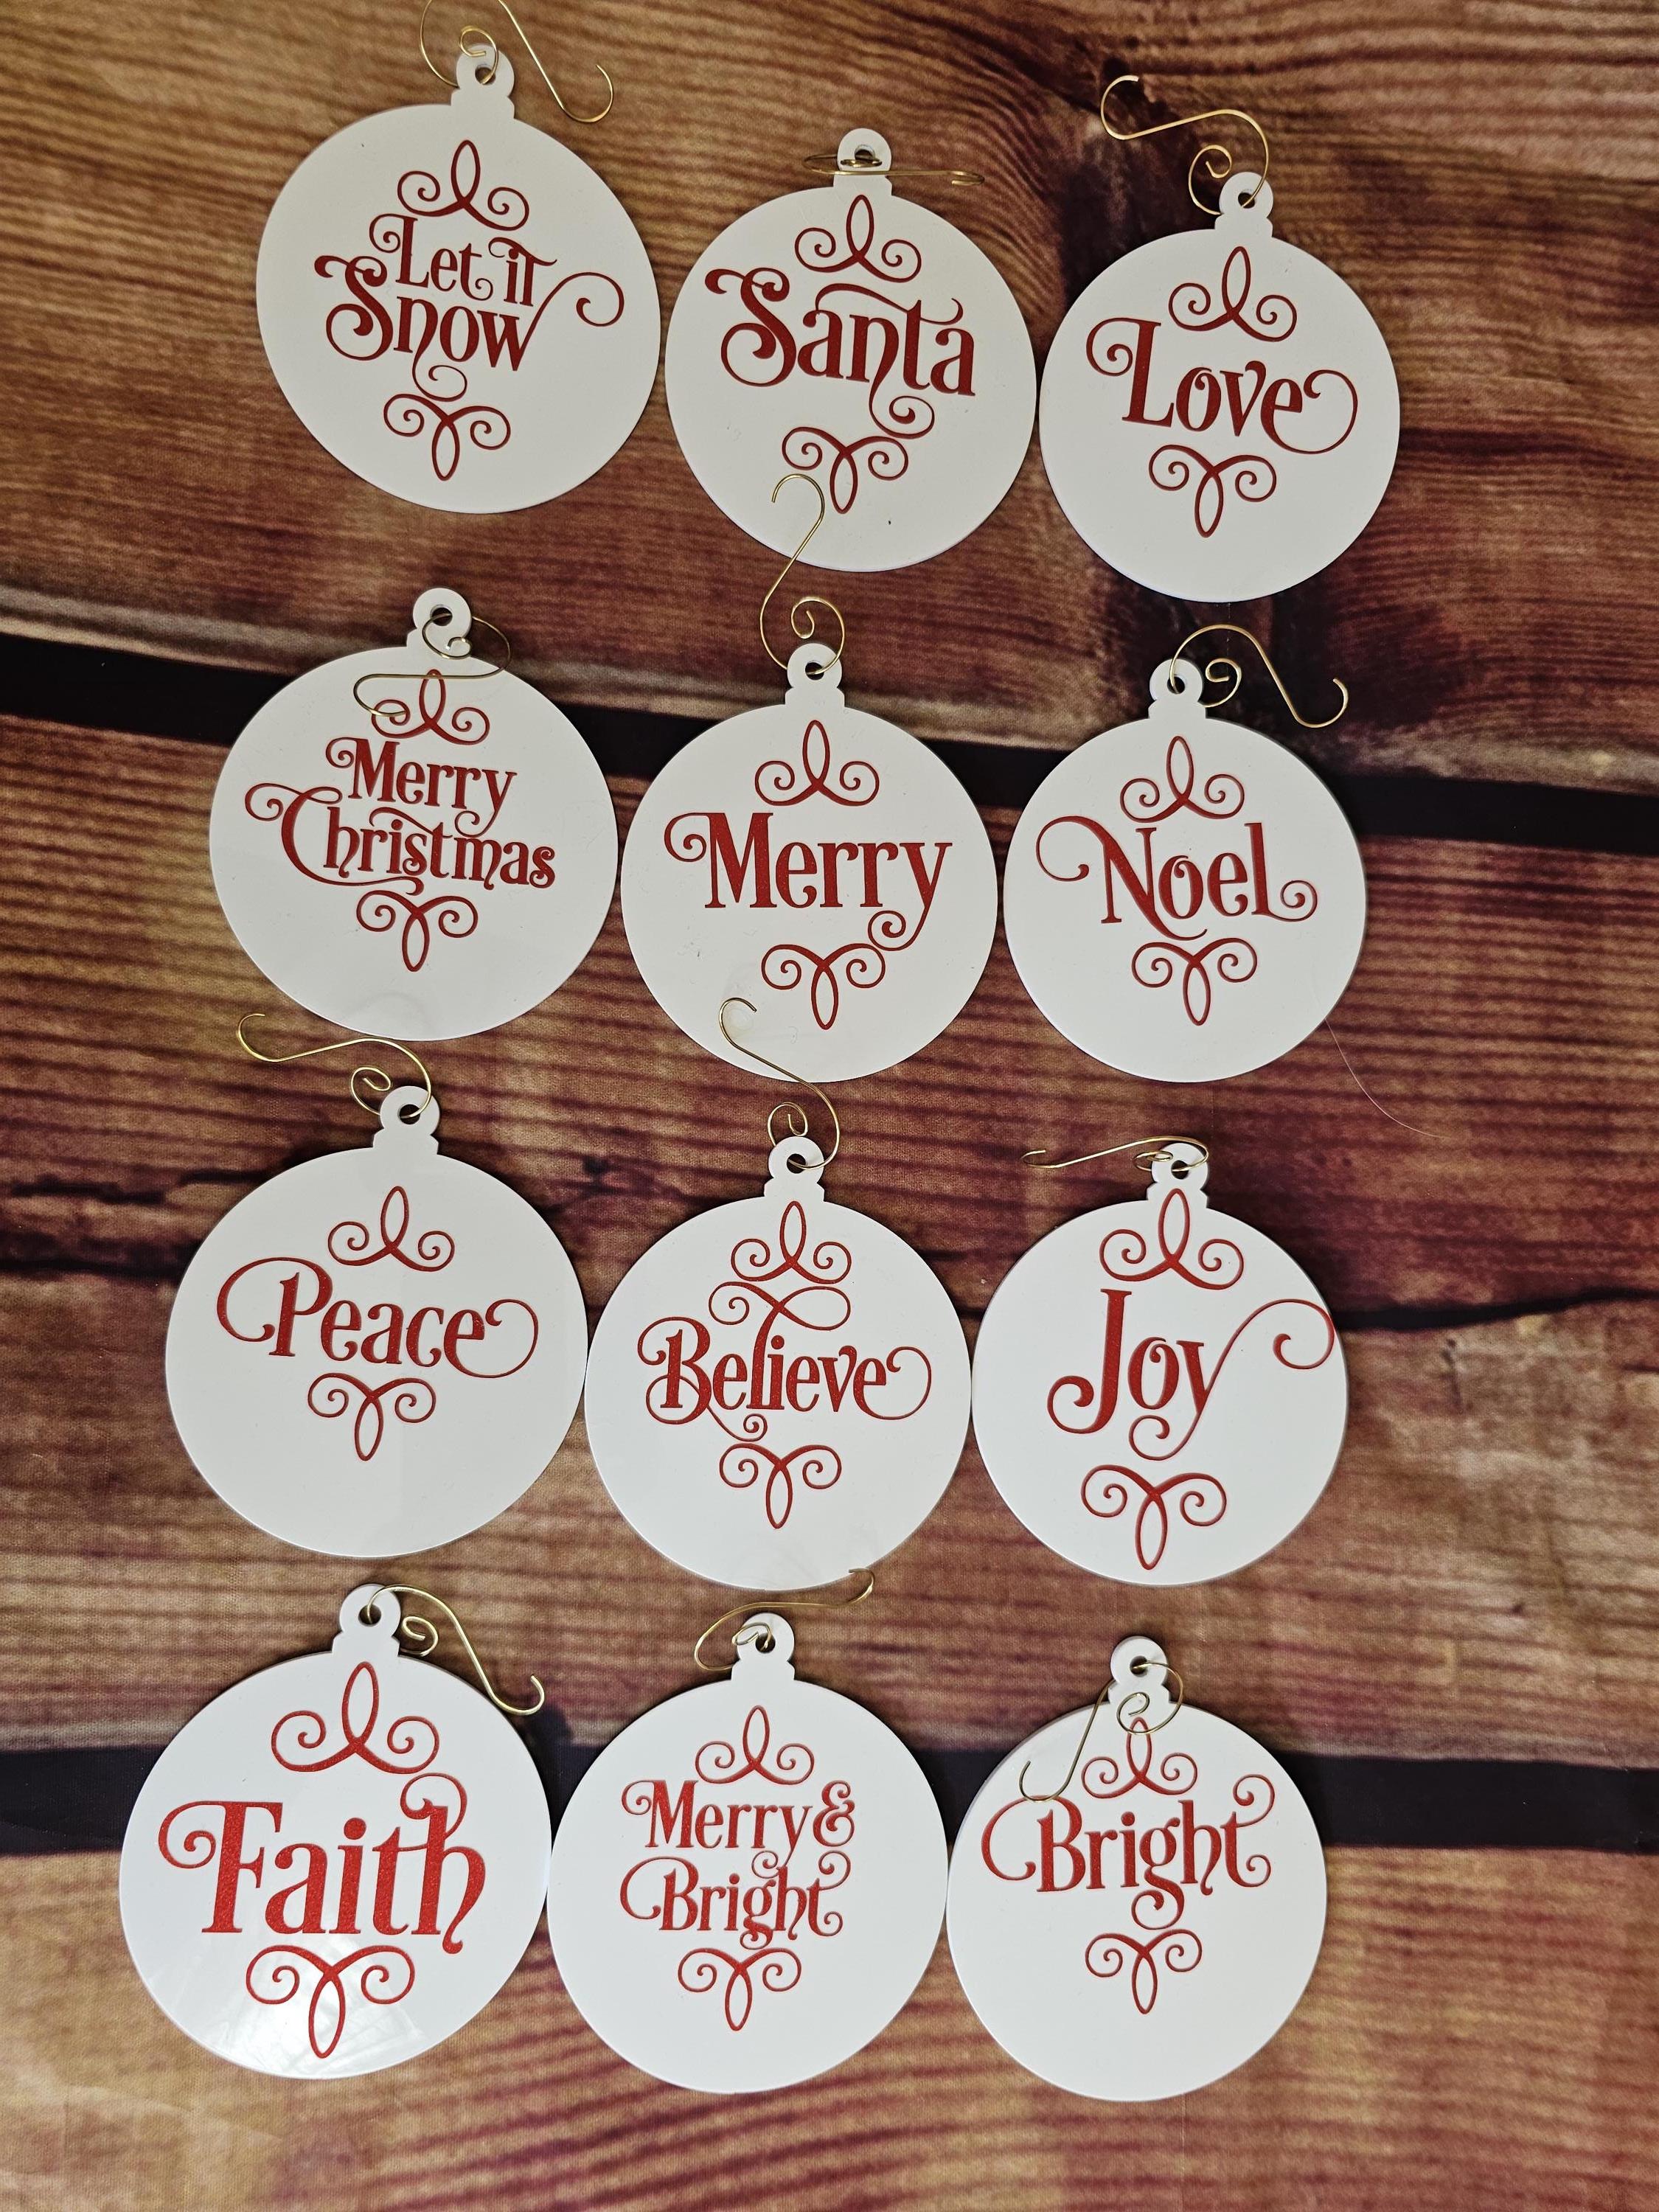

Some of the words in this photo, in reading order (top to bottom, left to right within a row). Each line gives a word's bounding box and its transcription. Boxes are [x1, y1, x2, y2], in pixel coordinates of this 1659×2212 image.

[369, 212, 494, 301] Let
[314, 254, 625, 401] Snow
[705, 267, 975, 439] Santa
[1086, 317, 1358, 454] Love
[245, 782, 555, 896] Christmas
[325, 737, 517, 838] Merry
[664, 812, 953, 951] Merry
[1036, 815, 1318, 941] Noel
[217, 1256, 539, 1379] Peace
[637, 1281, 932, 1441] Believe
[1047, 1288, 1335, 1461] Joy
[158, 1773, 486, 1954] Faith
[619, 1851, 852, 1950] Bright
[981, 1774, 1275, 1930] Bright
